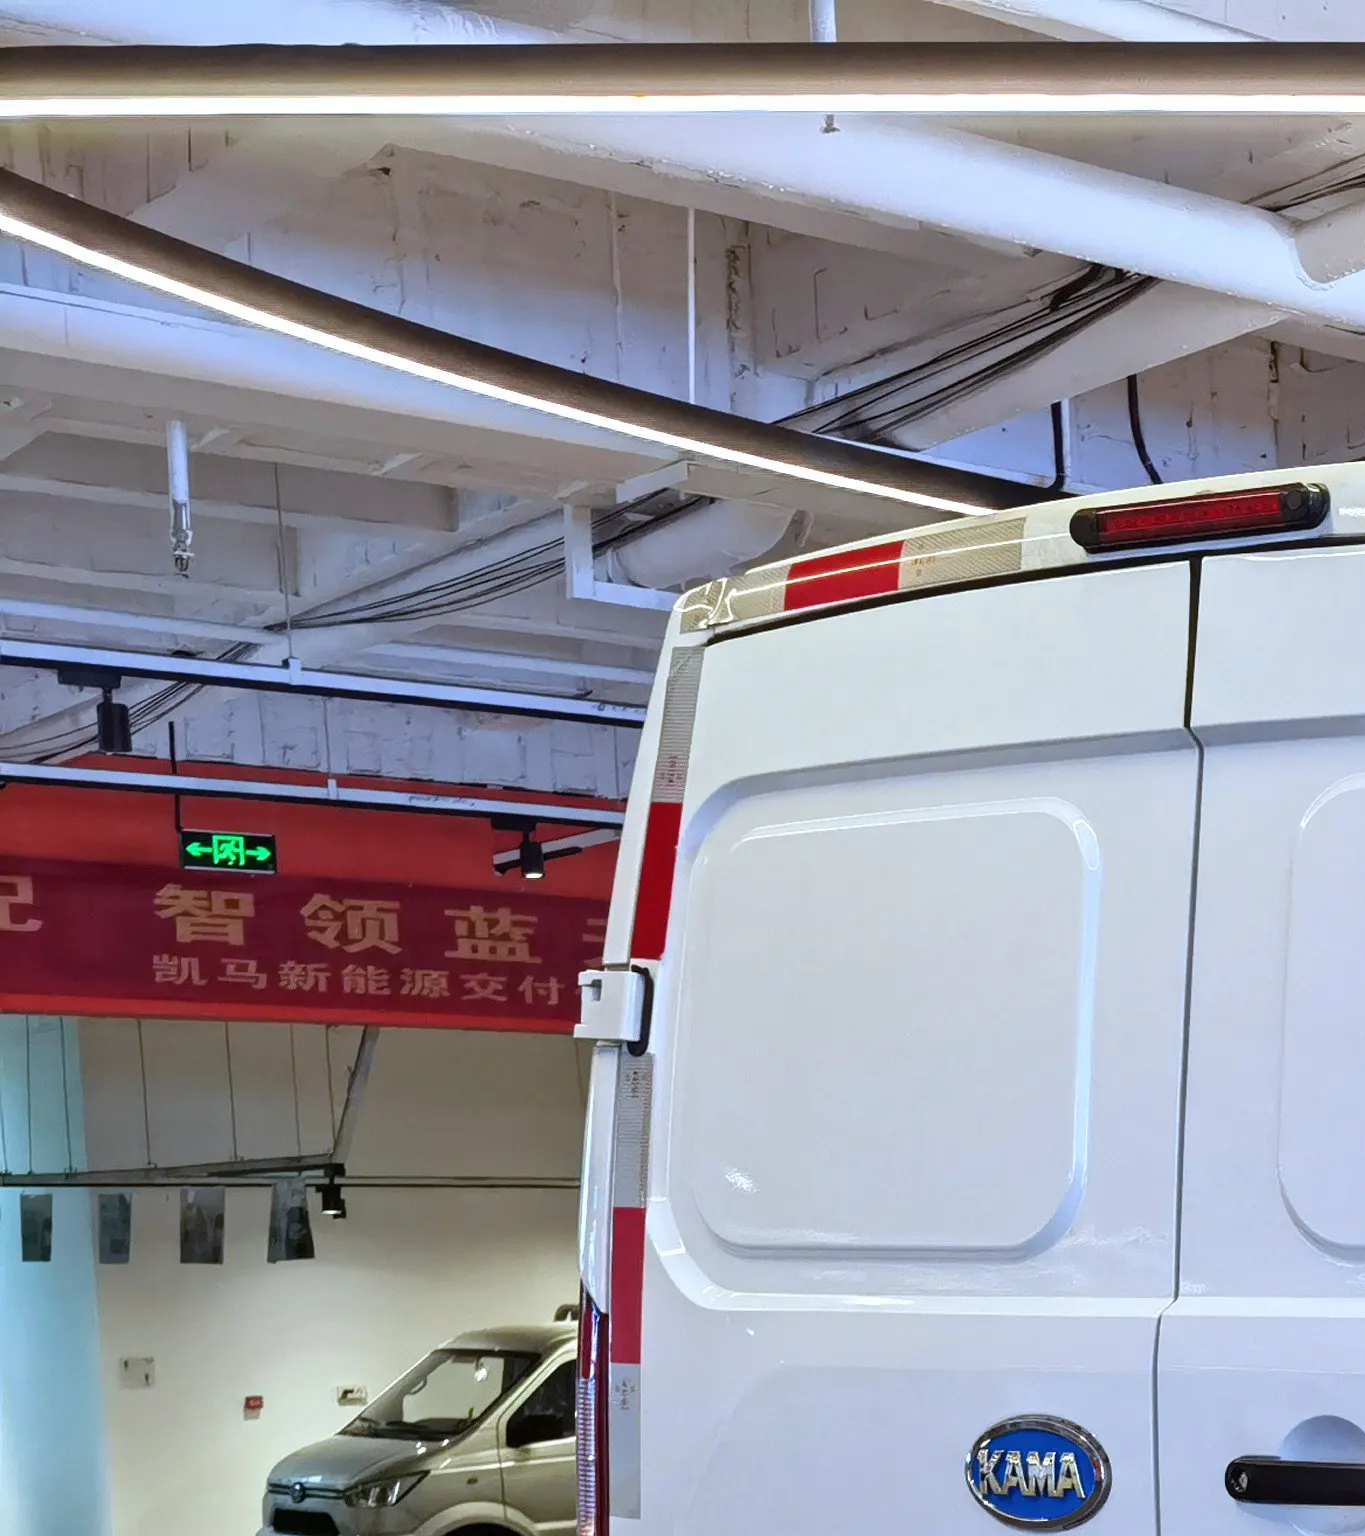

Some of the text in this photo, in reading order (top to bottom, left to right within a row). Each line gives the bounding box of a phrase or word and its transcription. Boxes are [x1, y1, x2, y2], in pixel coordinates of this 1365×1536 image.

[152, 953, 582, 1007] 凯马新能源交付
[977, 1449, 1086, 1499] KAMA
